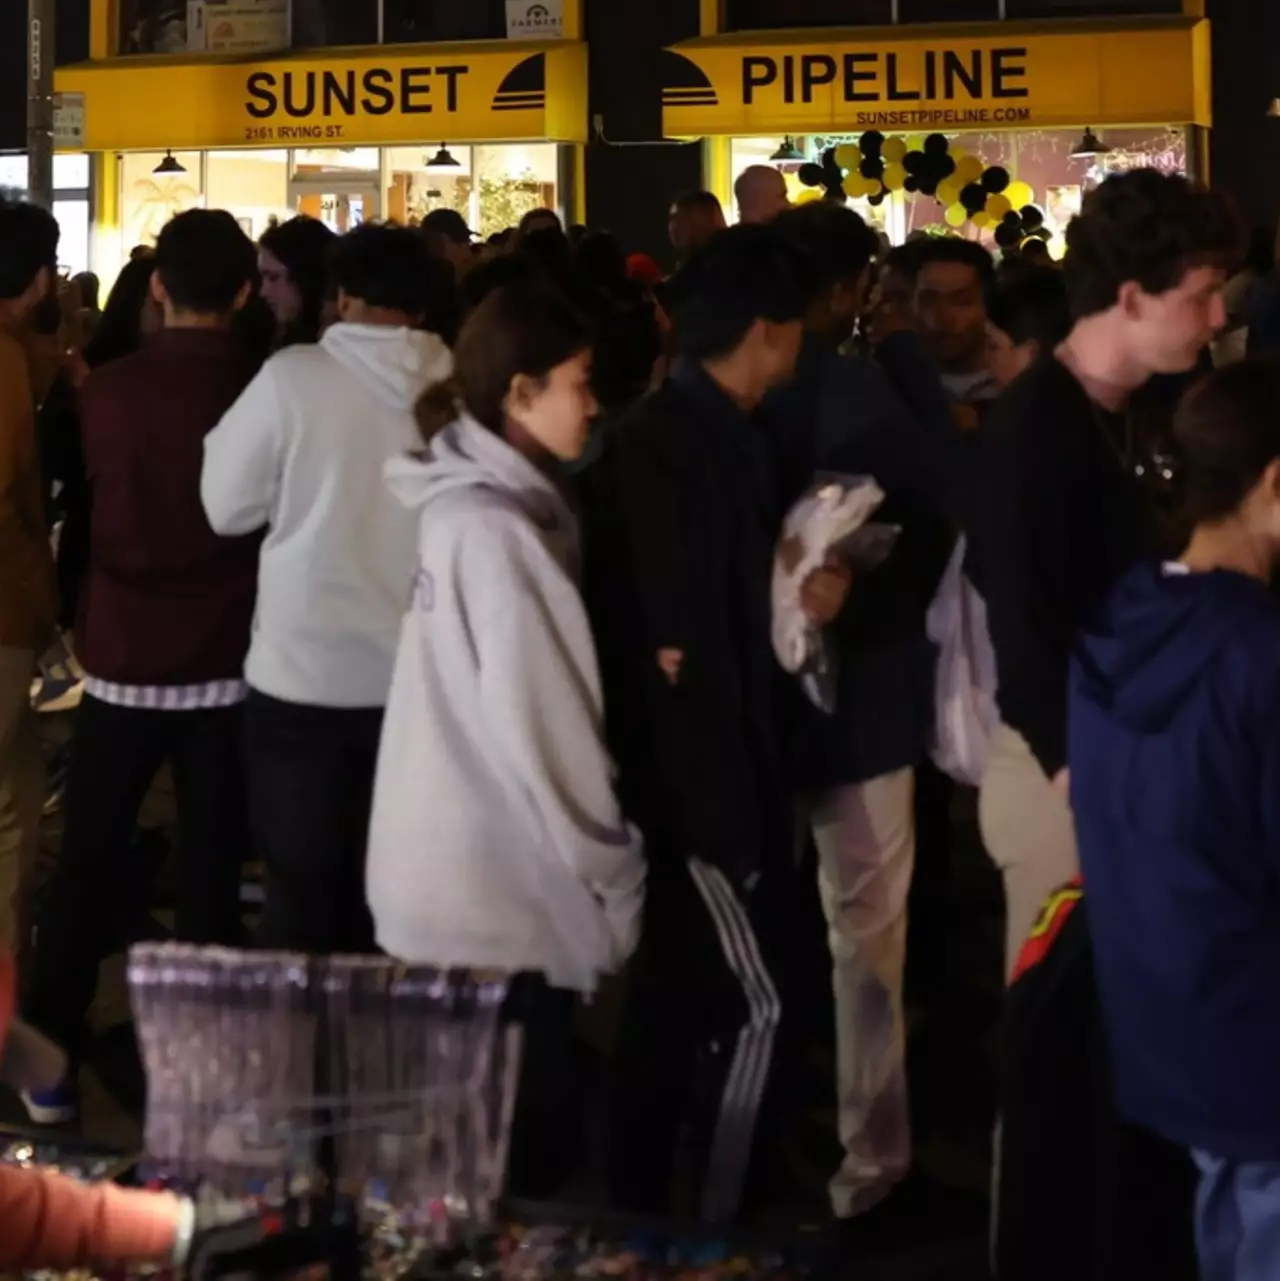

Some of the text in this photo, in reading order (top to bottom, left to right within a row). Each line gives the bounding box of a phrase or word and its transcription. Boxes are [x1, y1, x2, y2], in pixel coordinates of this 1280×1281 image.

[245, 65, 469, 119] SUNSET
[741, 47, 1029, 105] PIPELINE
[245, 126, 274, 140] 2161
[277, 124, 322, 139] IRVING
[856, 108, 1030, 125] SUNSETPIPELINE.COM
